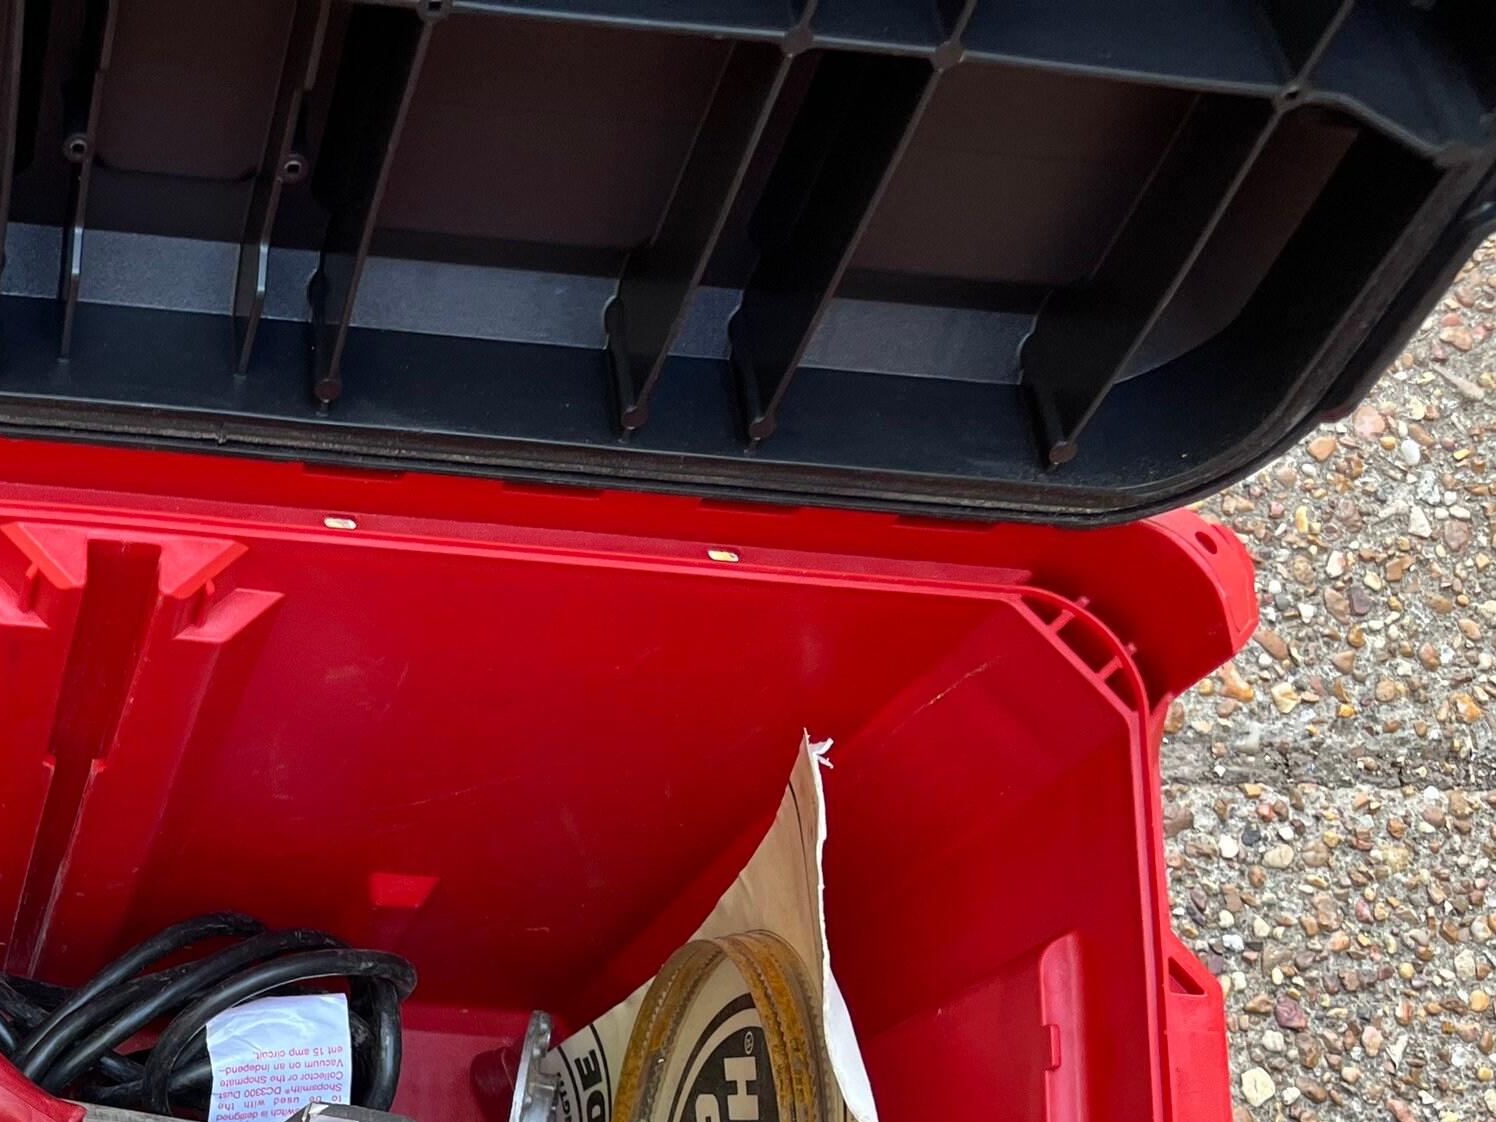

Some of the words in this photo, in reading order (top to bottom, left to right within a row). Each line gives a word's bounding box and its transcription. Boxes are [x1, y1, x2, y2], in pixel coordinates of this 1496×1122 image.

[289, 1048, 310, 1057] amp
[313, 1047, 324, 1057] 15
[328, 1045, 343, 1054] ent
[289, 1061, 301, 1069] on
[305, 1059, 344, 1068] Vacuum
[270, 1074, 286, 1083] the
[300, 1071, 344, 1081] Collector
[220, 1075, 268, 1087] Shopmate
[219, 1090, 241, 1100] Dust
[244, 1086, 282, 1098] DC3300
[244, 1100, 266, 1109] with
[273, 1096, 300, 1106] used
[217, 1102, 235, 1111] the
[216, 1111, 259, 1122] designed
